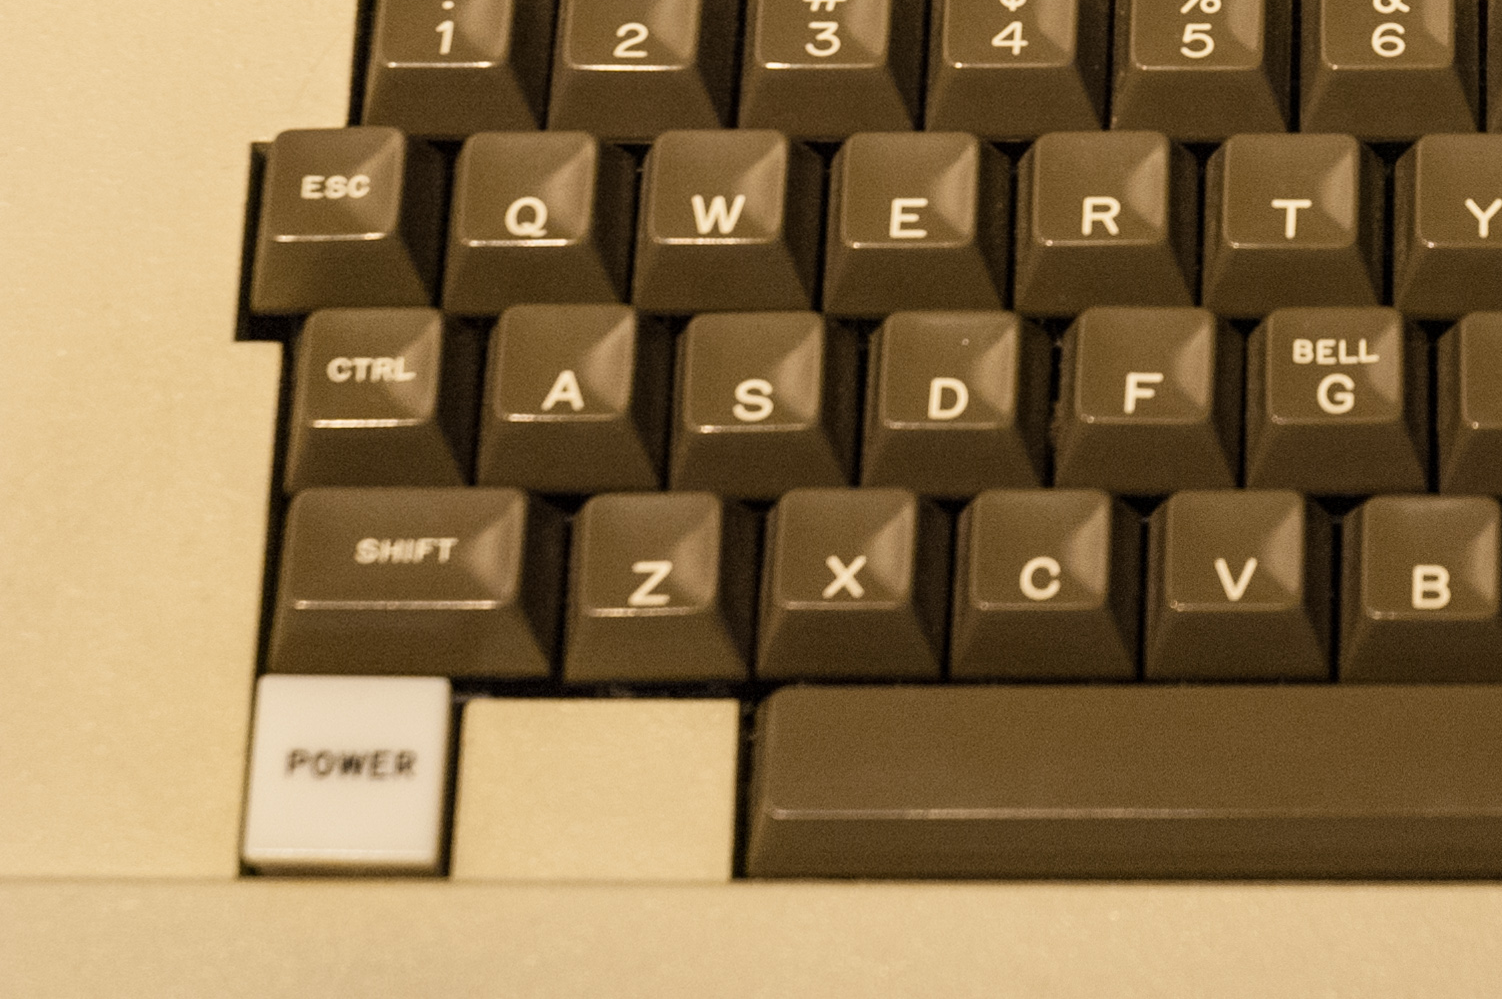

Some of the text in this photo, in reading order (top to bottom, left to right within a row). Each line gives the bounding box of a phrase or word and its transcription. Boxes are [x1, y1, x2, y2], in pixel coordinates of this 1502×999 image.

[435, 19, 455, 55] 1
[612, 21, 650, 59] 2
[804, 20, 842, 58] 3
[990, 20, 1029, 56] 4
[1179, 22, 1216, 59] 5
[1370, 21, 1407, 58] 6
[300, 172, 372, 200] ESC
[504, 195, 549, 238] Q
[690, 193, 748, 235] W
[888, 196, 929, 239] E
[1081, 195, 1122, 236] R
[1270, 198, 1313, 240] T
[326, 354, 418, 384] CTRL
[1292, 337, 1381, 366] BELL
[541, 369, 585, 411] A
[732, 377, 774, 422] S
[927, 376, 970, 420] D
[1123, 371, 1165, 414] F
[1316, 372, 1356, 415] G
[355, 536, 458, 564] SHIFT
[628, 559, 674, 605] Z
[823, 554, 868, 598] X
[1019, 555, 1062, 601] C
[1214, 557, 1258, 602] V
[1411, 563, 1452, 610] B
[286, 748, 416, 780] POWER
